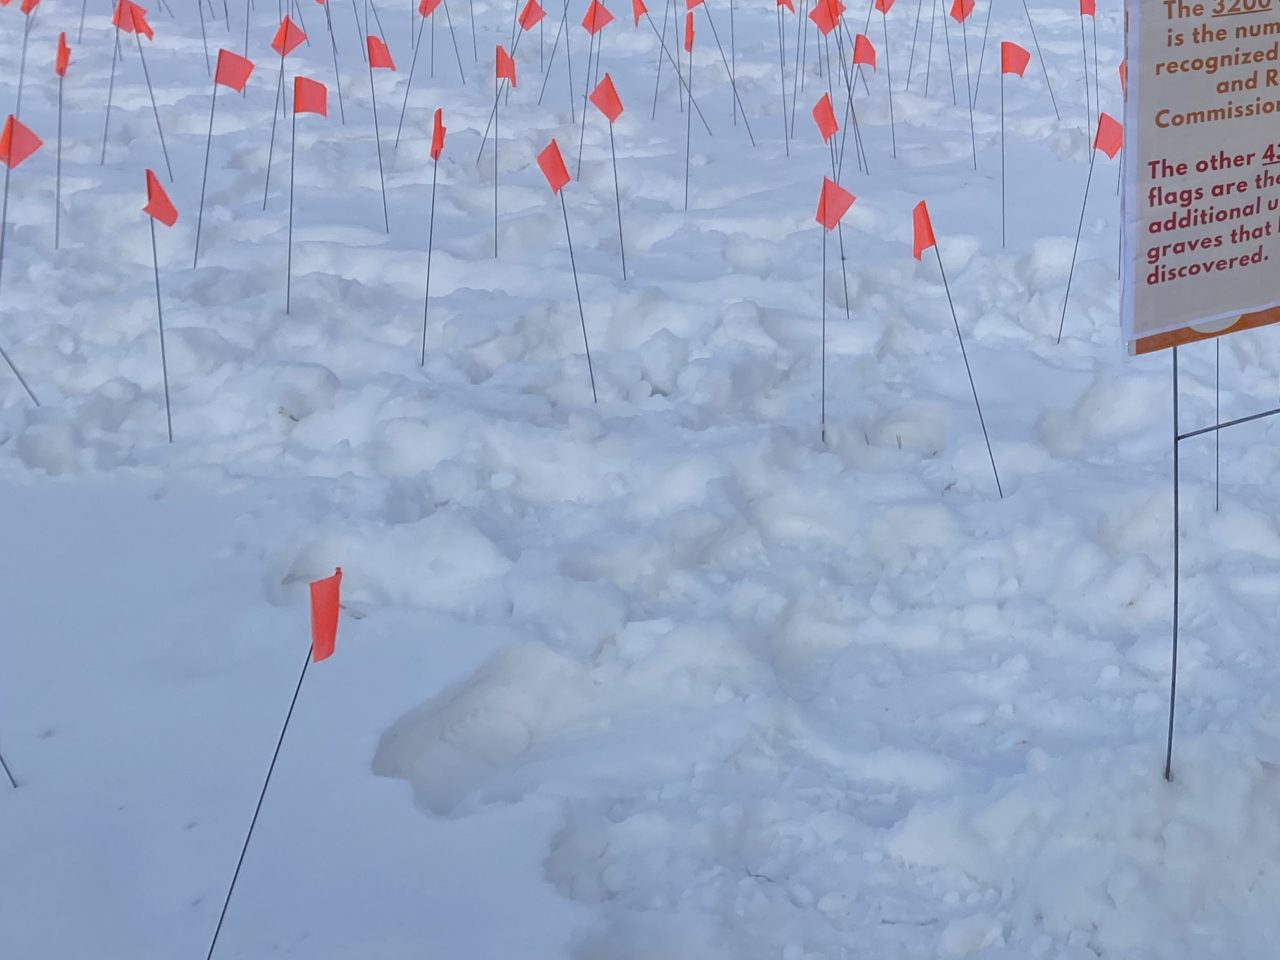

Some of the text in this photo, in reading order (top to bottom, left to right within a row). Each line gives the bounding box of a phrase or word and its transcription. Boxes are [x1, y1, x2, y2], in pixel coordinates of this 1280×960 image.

[1163, 0, 1204, 19] The
[1167, 28, 1184, 47] is
[1192, 24, 1227, 44] the
[1155, 41, 1279, 76] recognized
[1216, 71, 1258, 94] and
[1148, 159, 1188, 180] The
[1195, 151, 1256, 172] other
[1148, 183, 1204, 208] flags
[1211, 179, 1248, 198] are
[1148, 195, 1261, 234] additional
[1147, 233, 1223, 265] graves
[1230, 224, 1272, 245] that
[1146, 245, 1269, 285] discovered.
